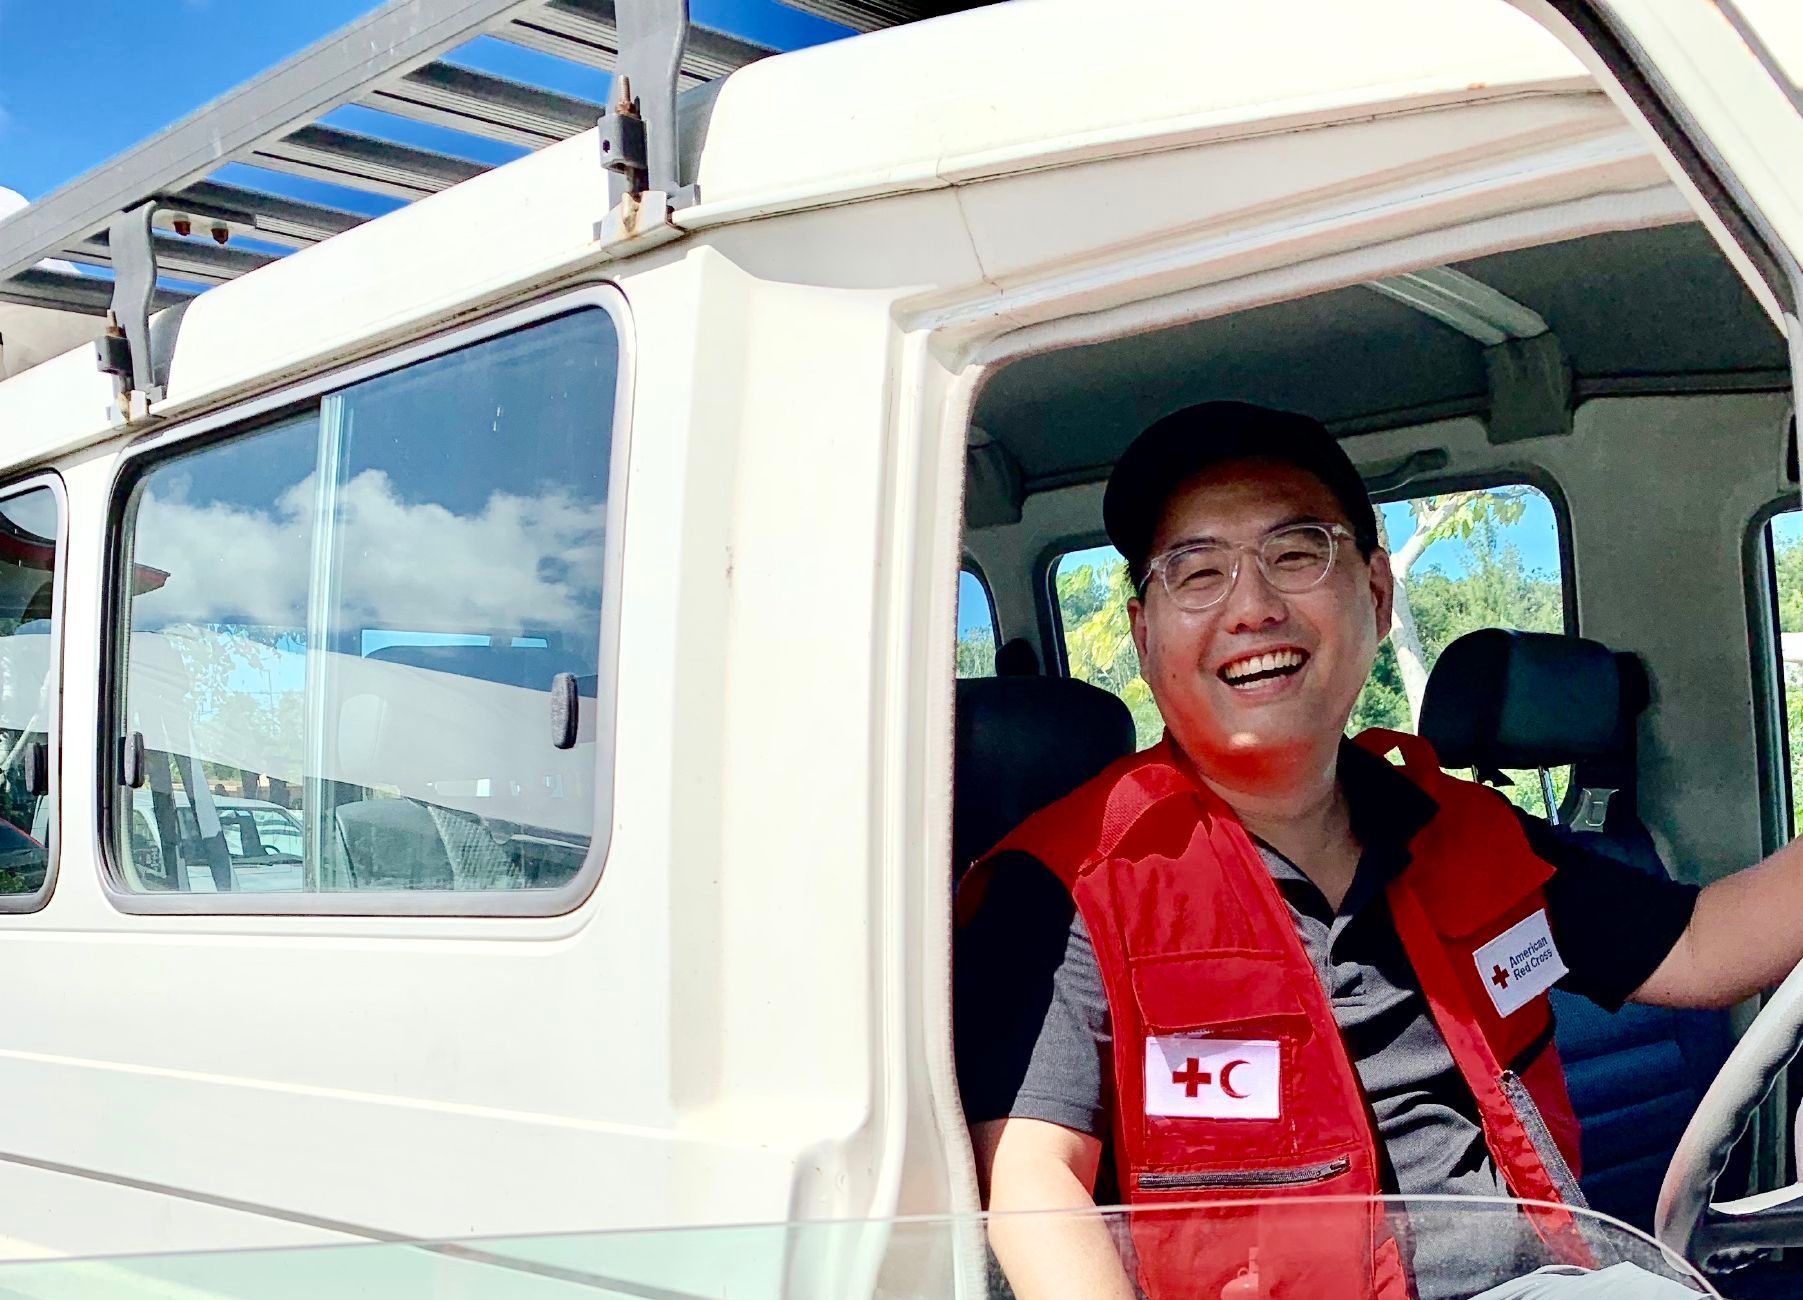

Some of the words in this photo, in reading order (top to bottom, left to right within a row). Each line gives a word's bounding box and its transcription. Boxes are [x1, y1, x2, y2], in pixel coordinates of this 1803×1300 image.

[1509, 936, 1548, 968] American
[1513, 963, 1532, 980] Red
[1530, 949, 1553, 968] Cross
